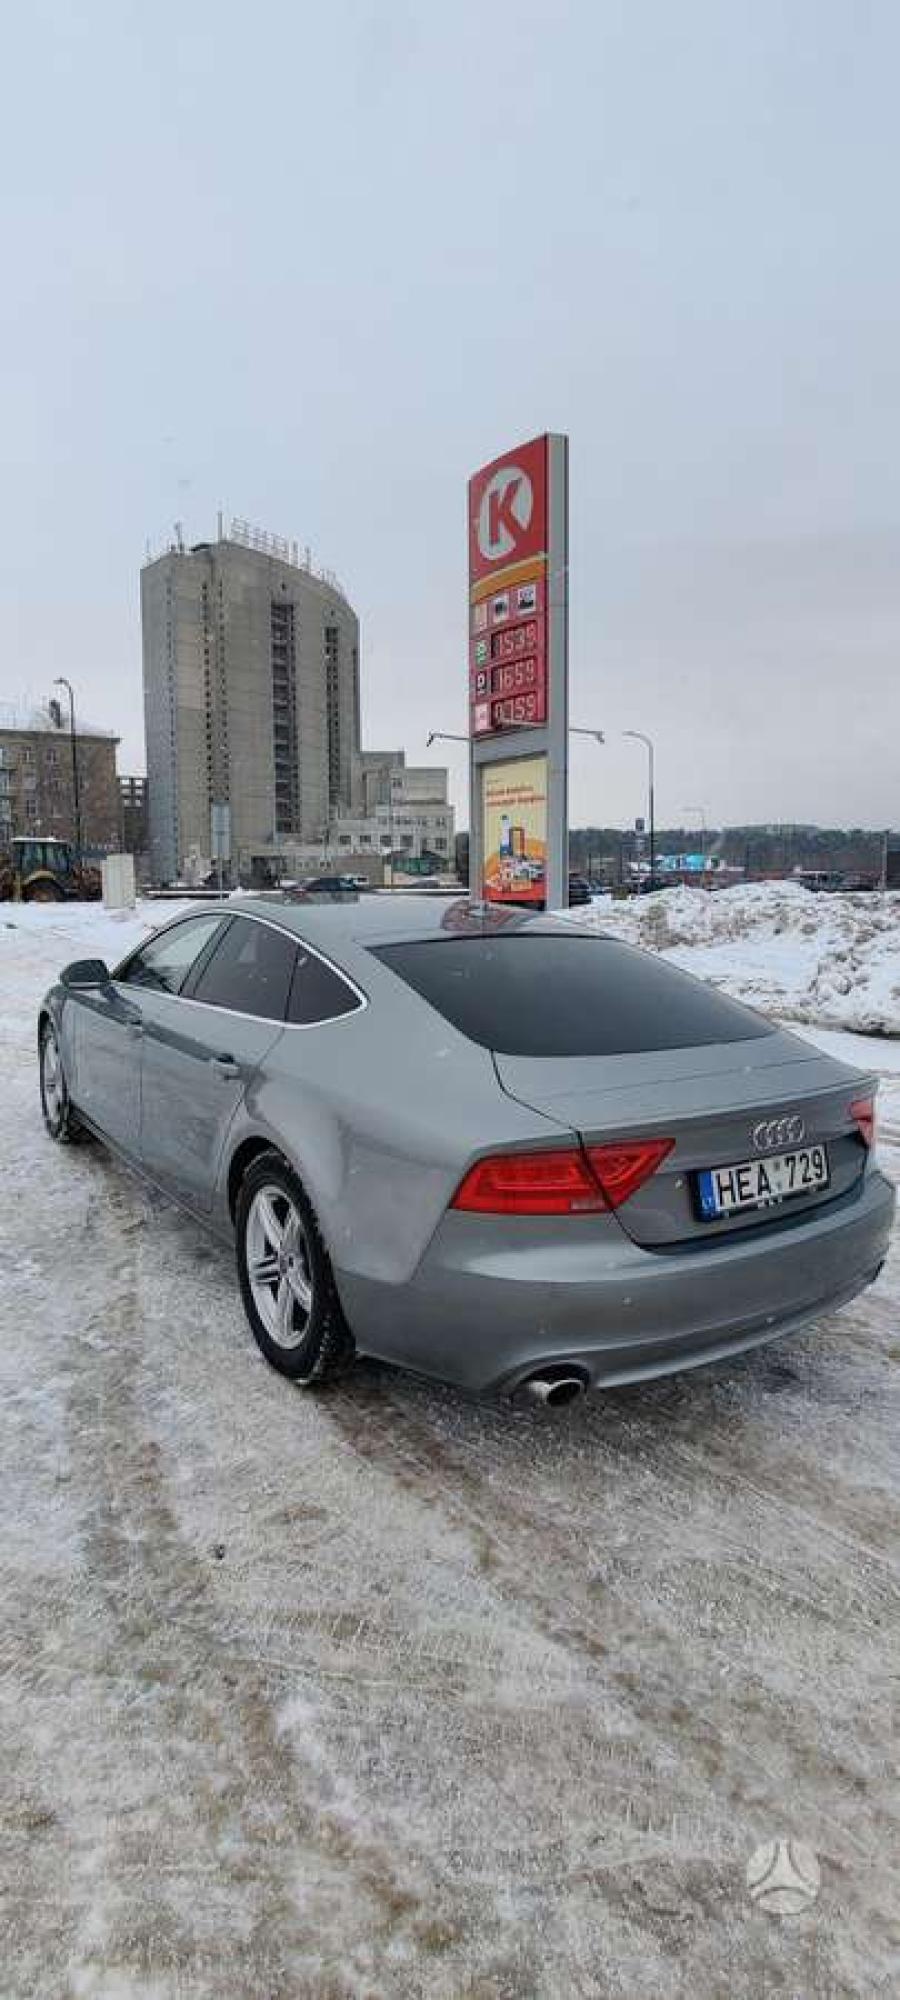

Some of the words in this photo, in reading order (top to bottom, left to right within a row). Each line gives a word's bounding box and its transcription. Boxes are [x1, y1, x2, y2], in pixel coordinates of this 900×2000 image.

[488, 477, 526, 547] K
[717, 1163, 772, 1207] HEA
[784, 1149, 824, 1188] 729
